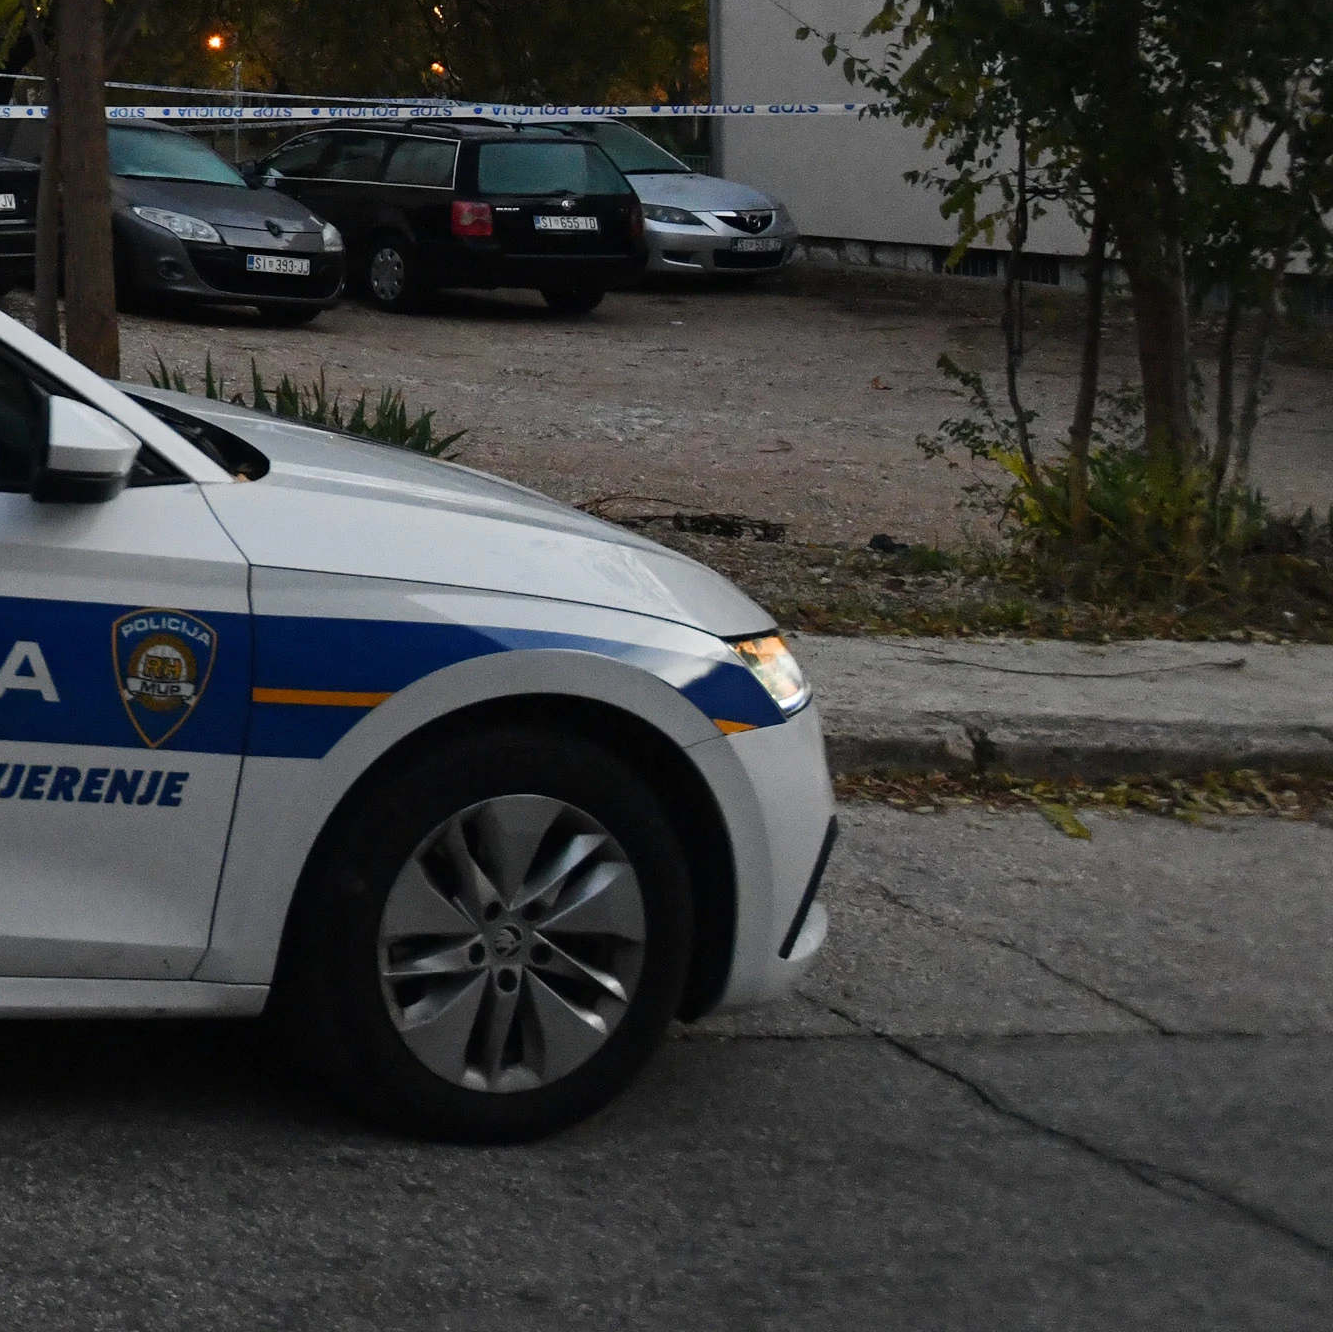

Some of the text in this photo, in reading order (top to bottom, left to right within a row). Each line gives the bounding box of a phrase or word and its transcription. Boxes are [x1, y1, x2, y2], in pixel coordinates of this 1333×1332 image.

[109, 108, 145, 117] STOP
[178, 108, 243, 118] POLICIJA
[253, 108, 292, 117] STOP
[328, 107, 398, 117] POLICIJA
[410, 107, 453, 117] STOP
[580, 106, 628, 115] STOP
[541, 217, 552, 228] SI
[255, 257, 309, 274] SI 393-JJ
[121, 617, 211, 648] POLICIJA
[145, 656, 182, 680] RH
[140, 680, 181, 695] MUP
